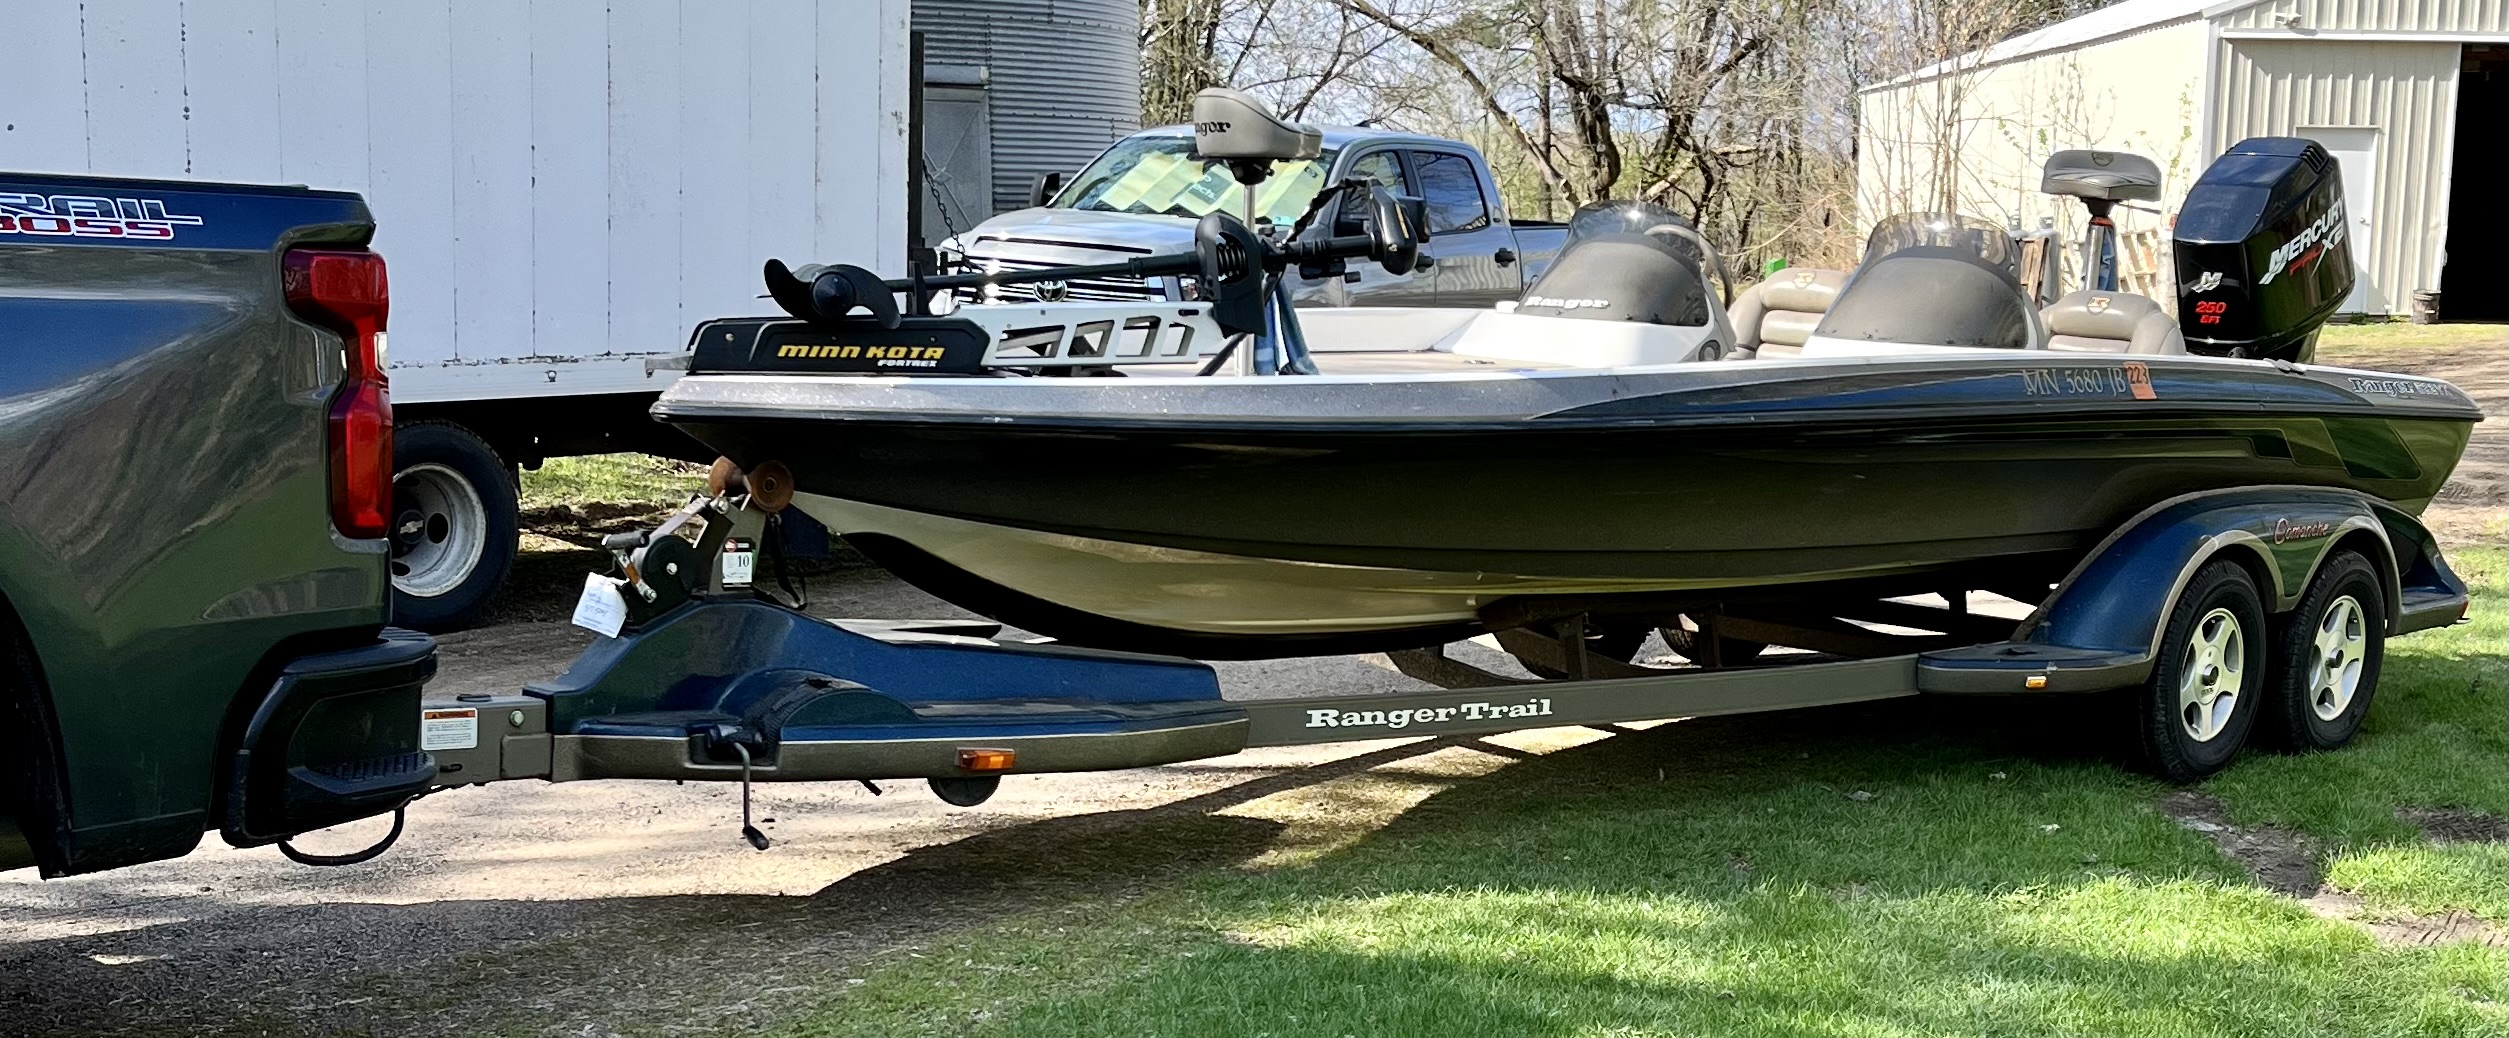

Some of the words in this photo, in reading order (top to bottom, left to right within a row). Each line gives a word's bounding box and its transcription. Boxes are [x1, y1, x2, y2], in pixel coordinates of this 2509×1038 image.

[2195, 300, 2227, 313] 250
[777, 345, 861, 358] MINN
[865, 346, 945, 360] KOTA
[877, 359, 938, 368] FORTREX
[2021, 368, 2060, 395] MN
[2064, 369, 2104, 394] 5680
[2347, 377, 2415, 397] Ranger
[738, 554, 750, 568] 10
[1305, 707, 1457, 729] Ranger
[1460, 698, 1553, 720] Trail
